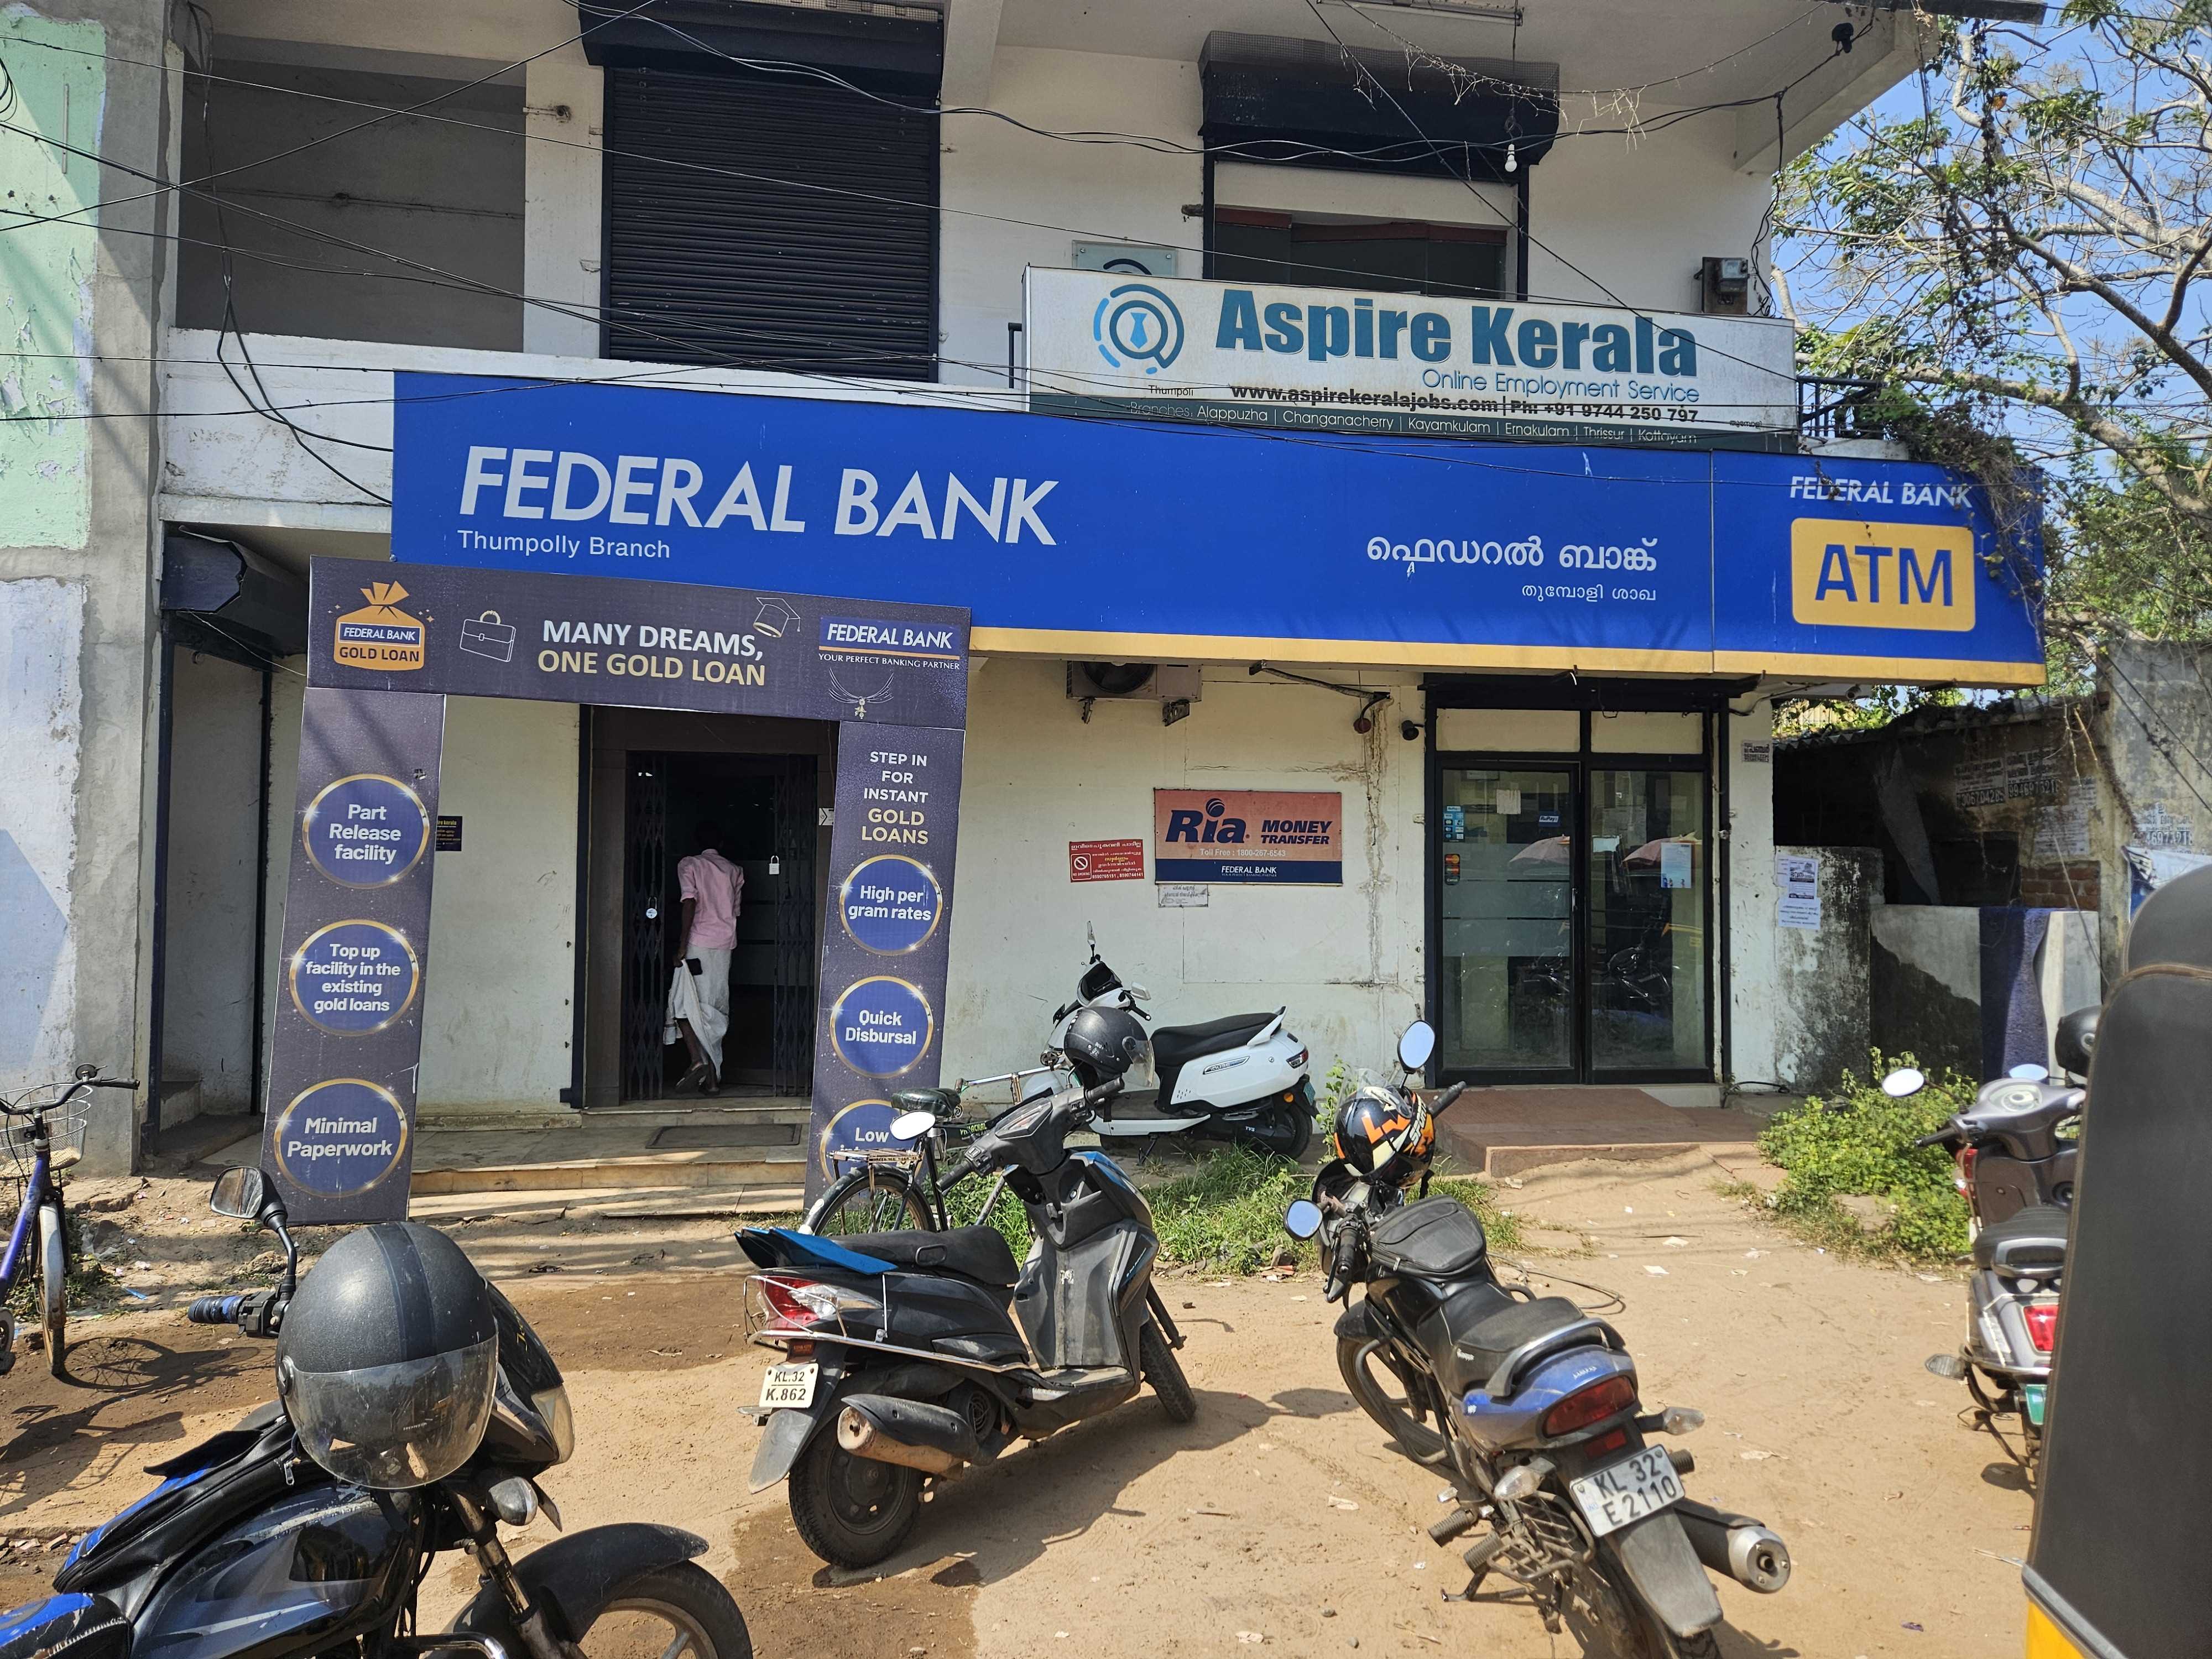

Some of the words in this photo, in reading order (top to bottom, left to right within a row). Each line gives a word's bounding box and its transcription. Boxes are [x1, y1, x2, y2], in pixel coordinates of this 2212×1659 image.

[1215, 289, 1452, 364] Aspire
[1472, 305, 1698, 378] Kerala
[1422, 368, 1487, 391] Online
[1496, 372, 1620, 399] Employment
[1628, 380, 1700, 403] Service
[1197, 405, 1268, 425] Alappuzha
[1283, 410, 1394, 431] Changanacherry
[1408, 415, 1490, 436] Kayamkulam
[1505, 422, 1569, 437] Ernakulam
[1583, 425, 1624, 441] Thrissur
[1582, 404, 1624, 420] 9744
[1630, 406, 1661, 421] 250
[1667, 408, 1698, 424] 797
[459, 445, 806, 533] FEDERAL
[833, 467, 1060, 546] BANK
[1790, 476, 1893, 504] FEDERAL
[1901, 482, 1973, 508] BANK
[458, 530, 580, 559] Thumpolly
[589, 535, 671, 559] Branch
[1366, 535, 1544, 567] ഫെഡറൽ
[1559, 536, 1658, 572] ബാങ്ക്
[1814, 544, 1954, 607] ATM
[1521, 583, 1604, 603] തുമ്പോളി
[1611, 588, 1656, 602] ശാഖ
[343, 627, 386, 640] FEDERAL
[387, 629, 416, 642] BANK
[542, 620, 631, 646] MANY
[639, 625, 764, 661] DREAMS,
[827, 623, 899, 646] FEDERAL
[902, 629, 954, 649] BANK
[339, 646, 377, 660] GOLD
[382, 649, 420, 662] LOAN
[818, 653, 844, 663] YOUR
[846, 655, 879, 665] PERFECT
[881, 658, 921, 669] BANKING
[923, 660, 960, 671] PARTNER
[538, 650, 598, 674] ONE
[607, 653, 684, 679] GOLD
[692, 659, 766, 687] LOAN
[869, 751, 907, 765] STEP
[911, 754, 927, 766] IN
[881, 770, 914, 784] FOR
[863, 787, 928, 804] INSTANT
[347, 804, 387, 821] Part
[868, 807, 925, 826] GOLD
[1165, 797, 1246, 844] Ria
[1261, 820, 1333, 834] MONEY
[329, 823, 401, 842] Release
[861, 826, 929, 846] LOANS
[1260, 834, 1331, 845] TRANSFER
[334, 844, 397, 865] facility
[1237, 849, 1286, 857] 1800-267-6543
[1221, 865, 1253, 874] FEDERAL
[1255, 866, 1277, 874] BANK
[860, 885, 895, 904] High
[898, 890, 924, 905] per
[848, 905, 889, 920] gram
[891, 906, 932, 921] rates
[330, 943, 359, 960] Top
[361, 946, 380, 959] up
[305, 961, 357, 979] facility
[360, 962, 373, 975] in
[376, 962, 401, 977] the
[321, 980, 382, 995] existing
[314, 998, 347, 1014] gold
[349, 998, 390, 1011] loans
[859, 1009, 902, 1026] Quick
[844, 1027, 917, 1045] Disbursal
[304, 1117, 378, 1134] Minimal
[855, 1126, 890, 1143] Low
[287, 1140, 393, 1161] Paperwork
[774, 1371, 805, 1383] KL.32
[765, 1387, 807, 1401] K.862
[1593, 1470, 1628, 1500] KL
[1629, 1453, 1662, 1482] 32
